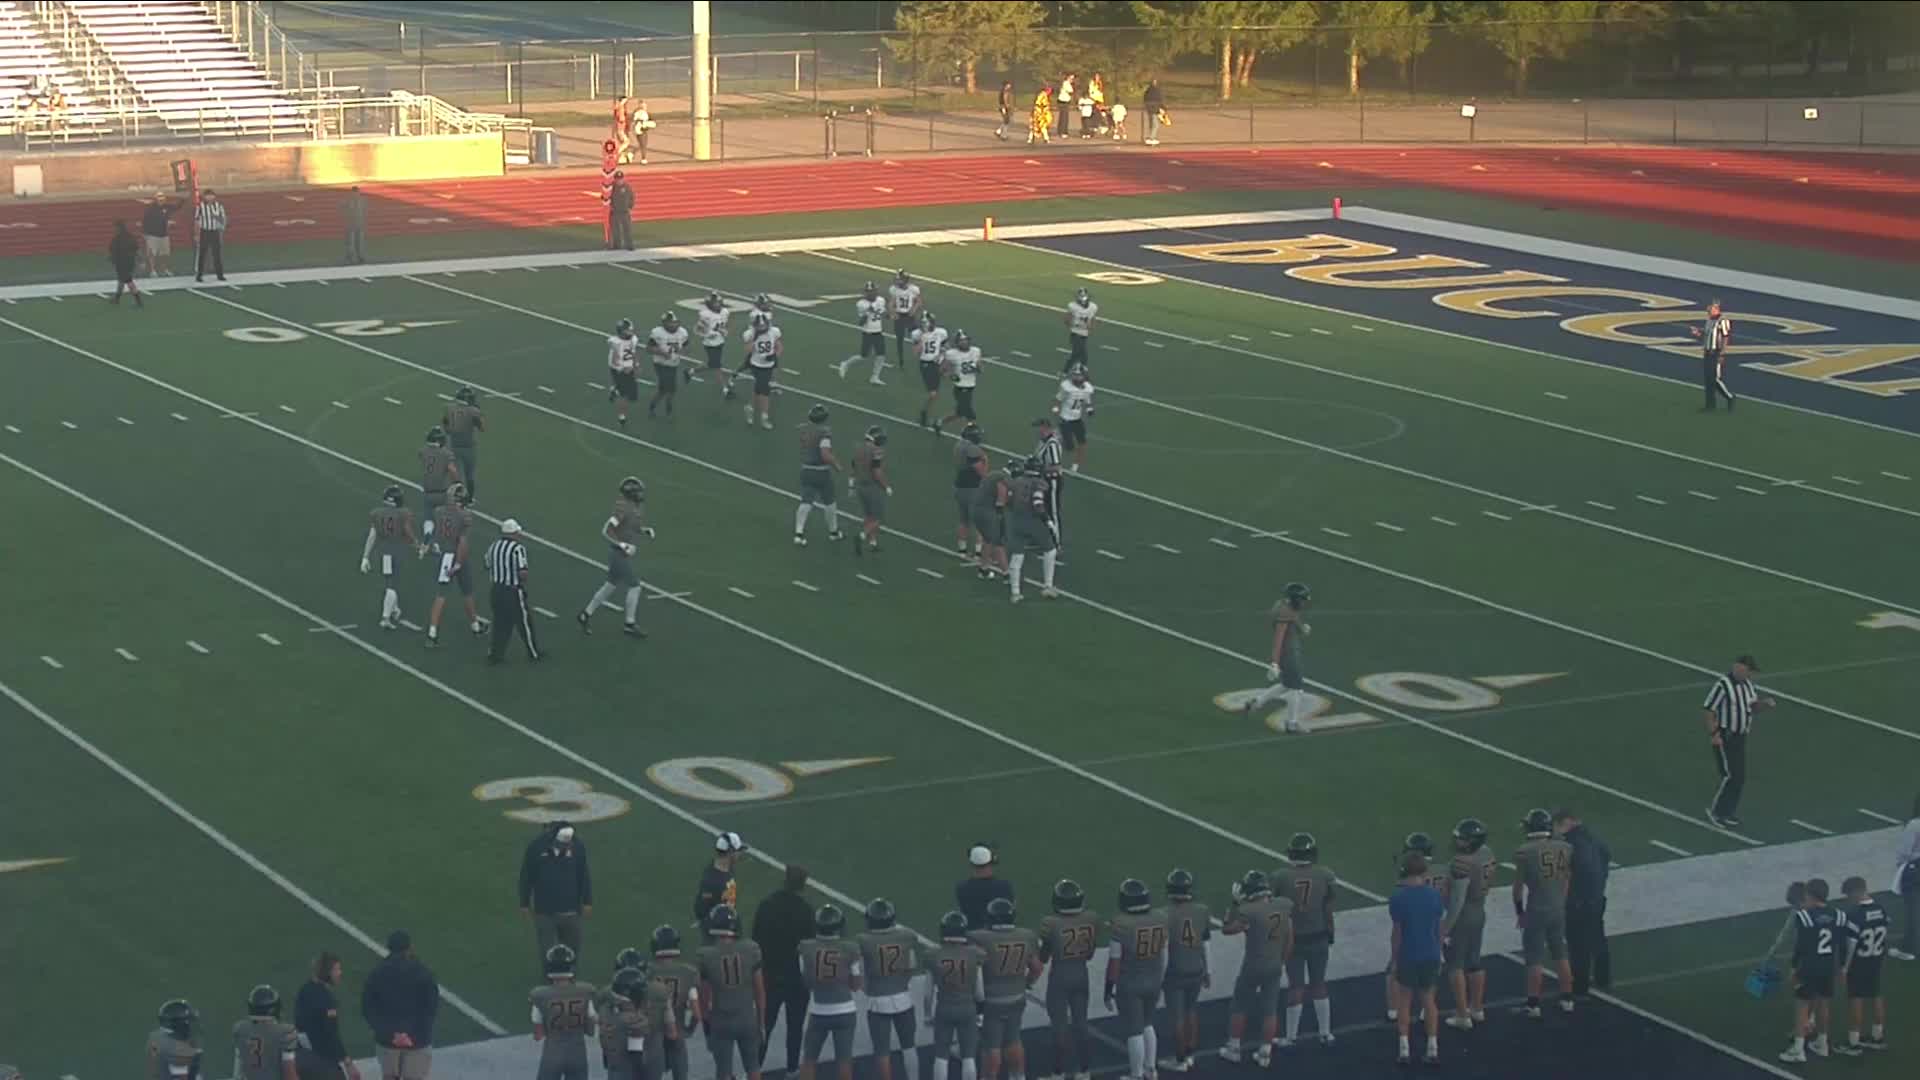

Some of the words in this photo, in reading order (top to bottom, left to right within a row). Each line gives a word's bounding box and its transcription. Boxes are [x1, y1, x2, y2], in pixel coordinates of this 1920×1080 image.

[924, 341, 937, 354] 15
[473, 757, 795, 823] 30
[1294, 878, 1311, 906] 7
[1136, 923, 1165, 960] 60
[1179, 918, 1196, 951] 4
[1817, 928, 1832, 955] 2
[1857, 925, 1887, 957] 32
[720, 952, 741, 986] 11
[815, 948, 840, 982] 15
[995, 942, 1025, 974] 77
[550, 998, 585, 1030] 25
